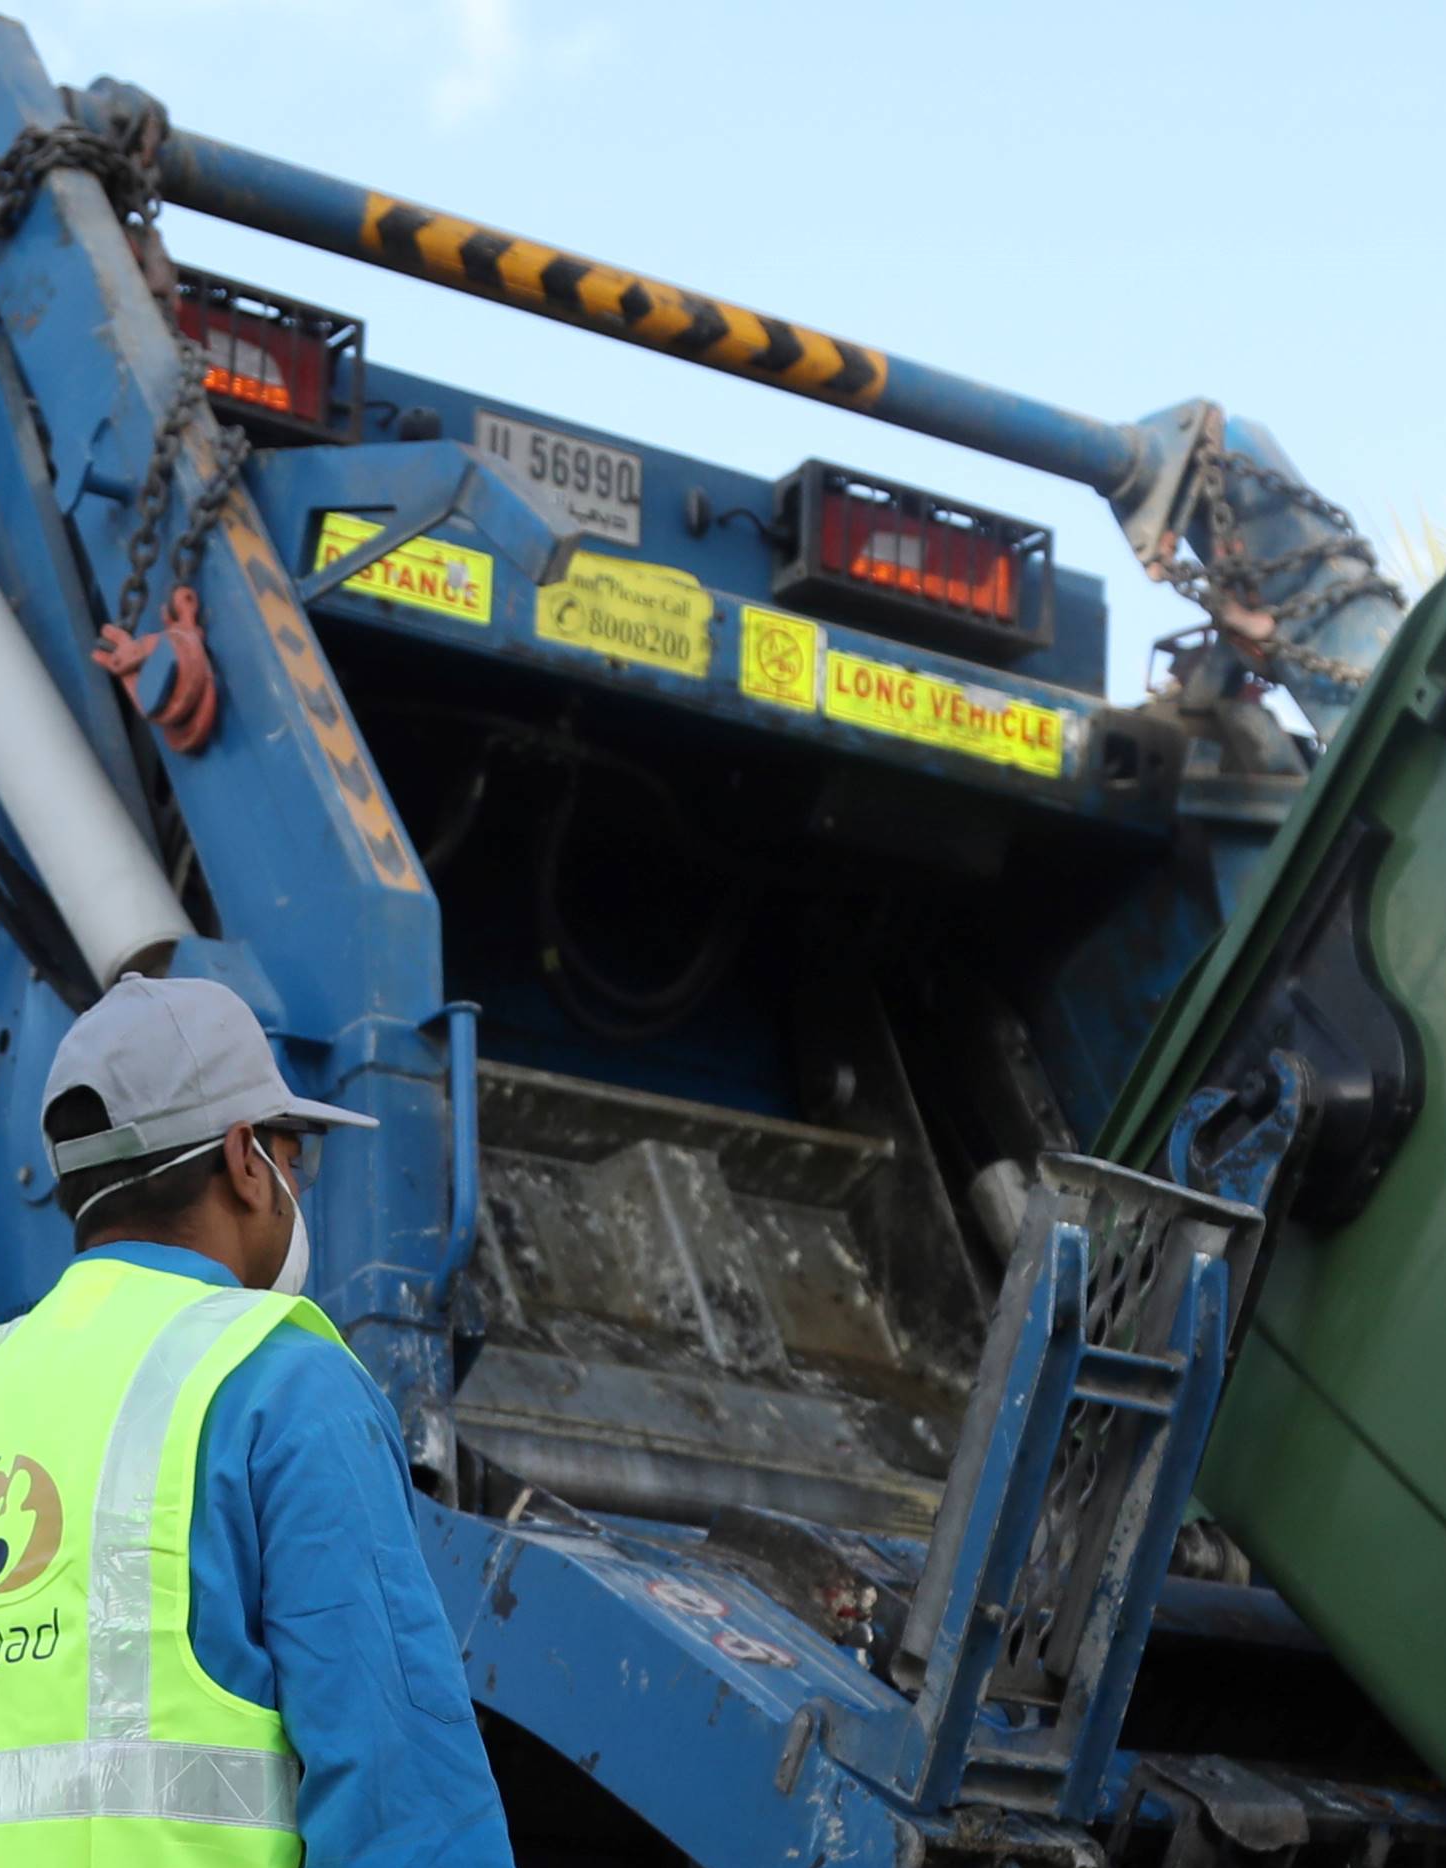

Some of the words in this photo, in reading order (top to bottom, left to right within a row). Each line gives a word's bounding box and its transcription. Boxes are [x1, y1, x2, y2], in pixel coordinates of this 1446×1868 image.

[530, 431, 639, 504] 56990
[588, 606, 692, 661] 8008200
[835, 662, 918, 710] LONG
[930, 686, 1054, 748] VEHICLE
